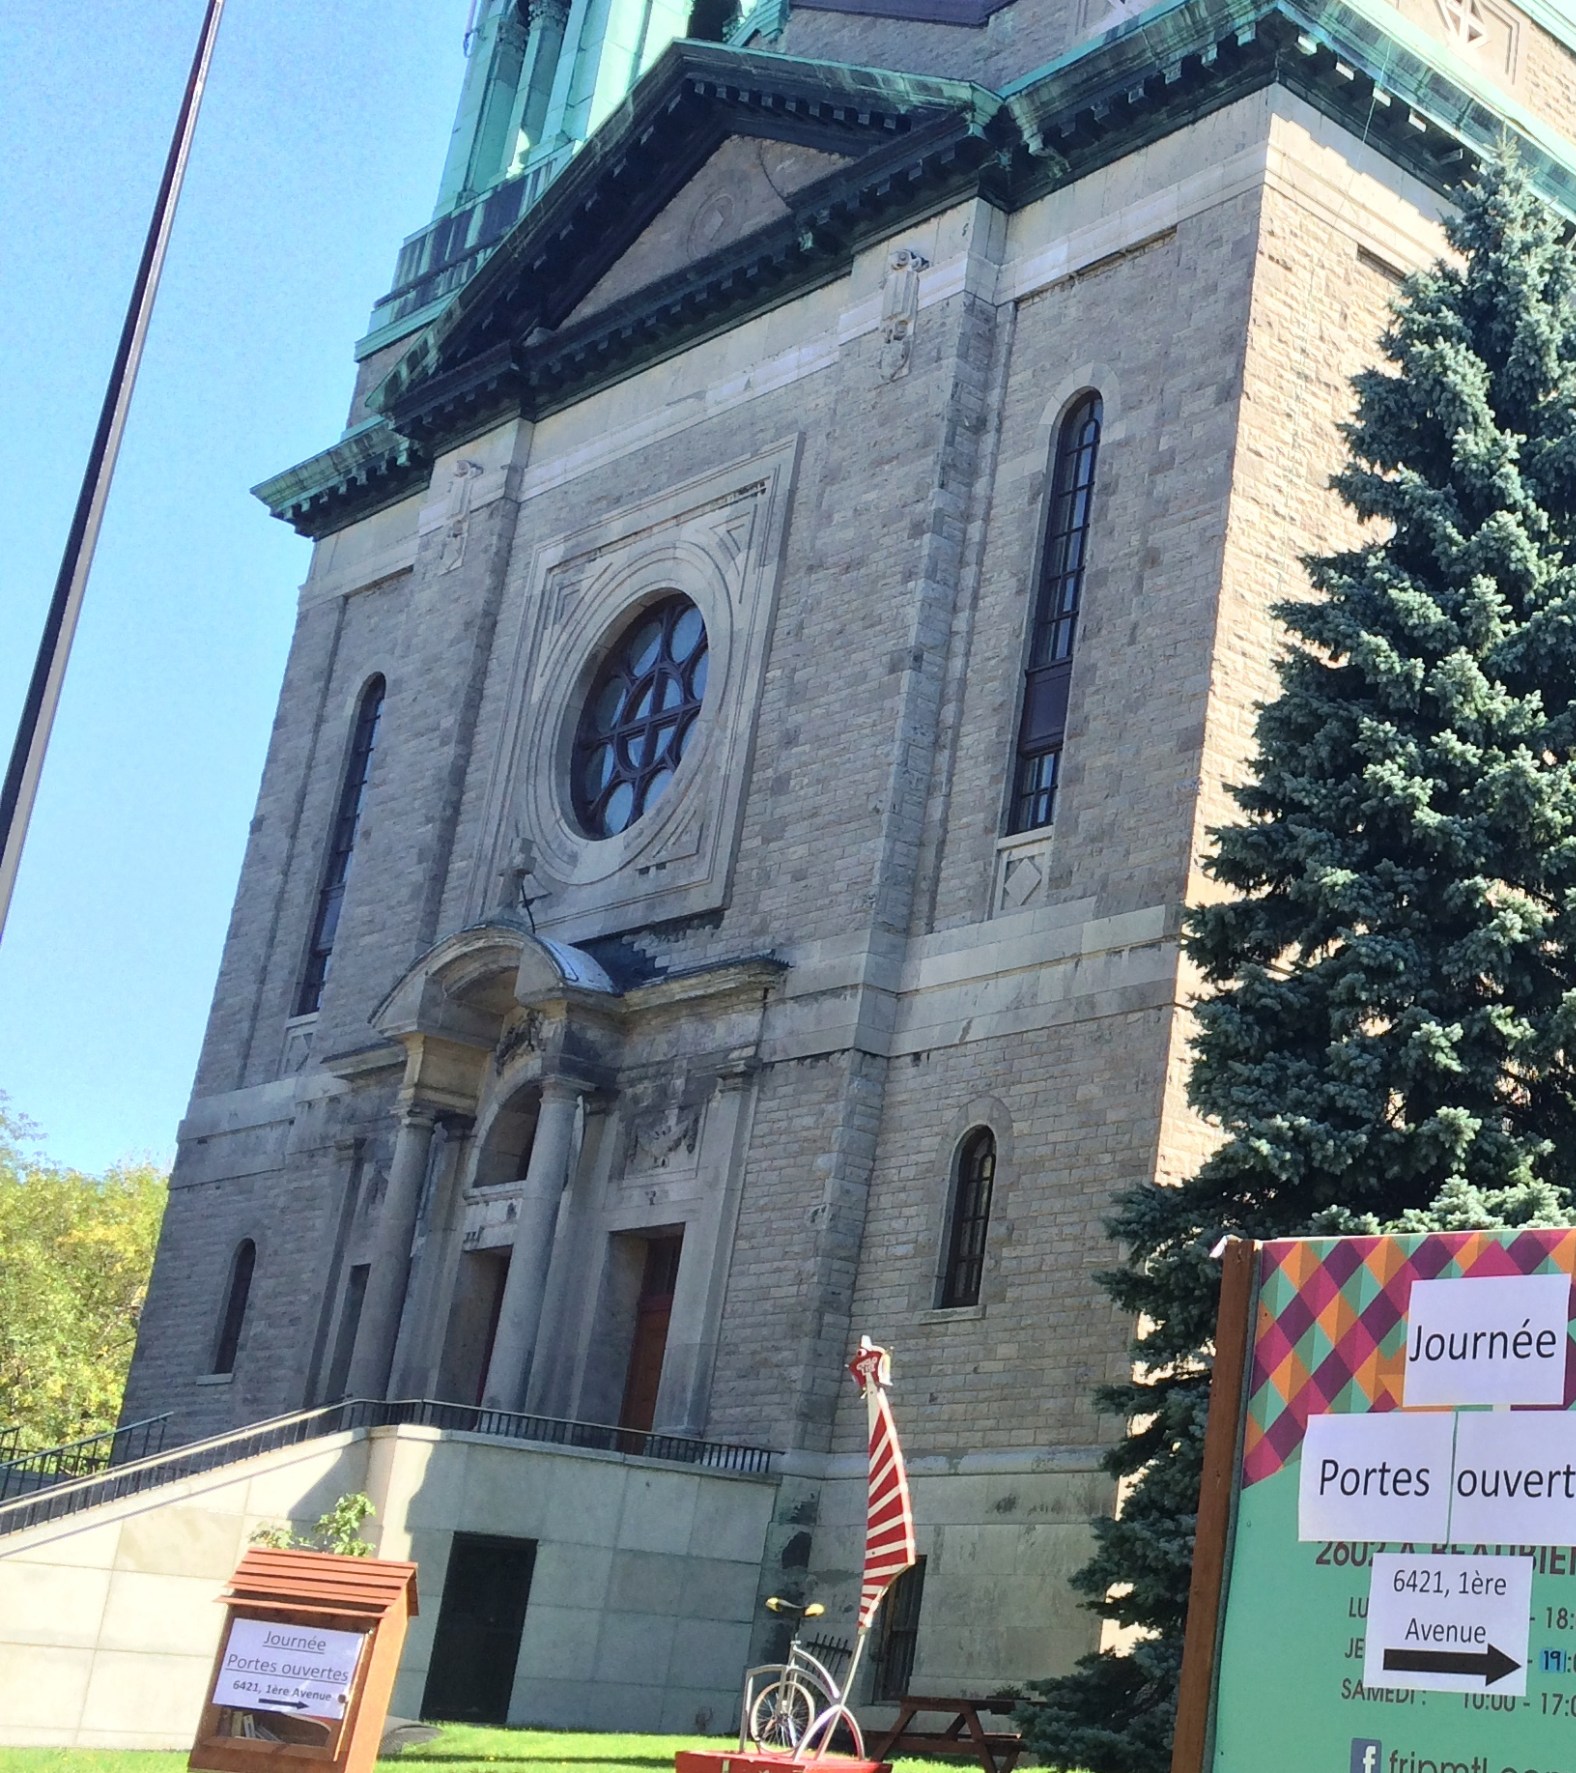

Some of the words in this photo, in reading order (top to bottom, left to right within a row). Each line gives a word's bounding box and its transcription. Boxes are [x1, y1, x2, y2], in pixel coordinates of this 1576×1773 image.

[1409, 1318, 1557, 1361] Journée
[1319, 1459, 1430, 1497] Portes
[1393, 1569, 1450, 1598] 6421,
[1458, 1570, 1507, 1596] 1ère
[263, 1631, 327, 1651] Journée
[1404, 1618, 1487, 1644] Avenue
[227, 1654, 277, 1673] Portes
[281, 1663, 349, 1682] ouvertes
[233, 1680, 262, 1694] 6421,
[266, 1684, 290, 1697] 1ère
[292, 1688, 332, 1702] Avenue
